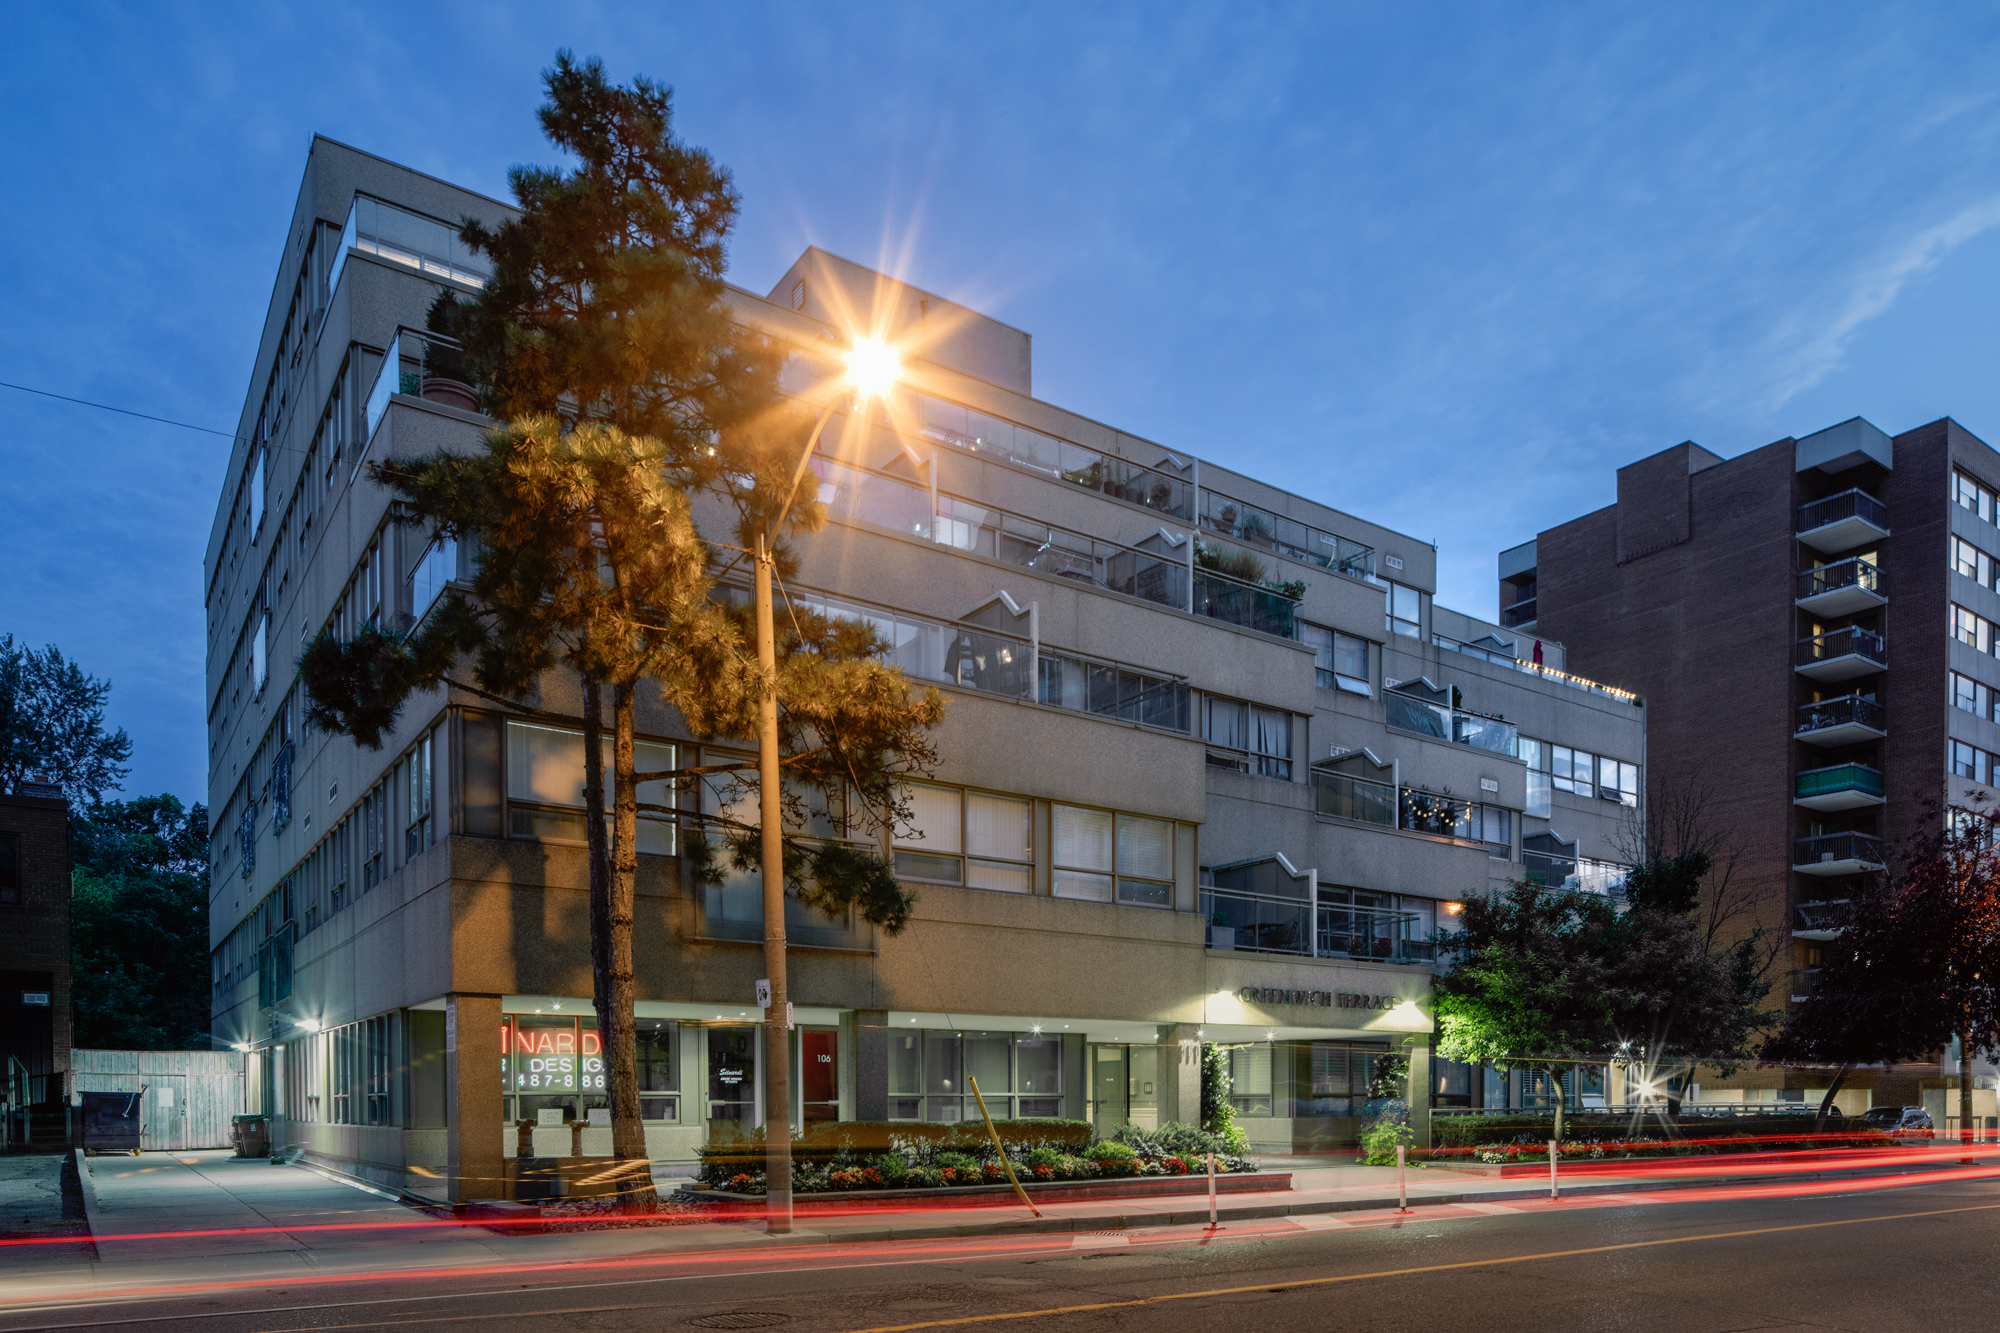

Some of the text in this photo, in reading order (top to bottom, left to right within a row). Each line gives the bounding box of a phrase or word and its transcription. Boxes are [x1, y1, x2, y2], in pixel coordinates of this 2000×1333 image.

[1240, 986, 1396, 1010] GREENWICH TERRACE
[530, 1058, 604, 1072] DESIG
[817, 1054, 831, 1063] 106
